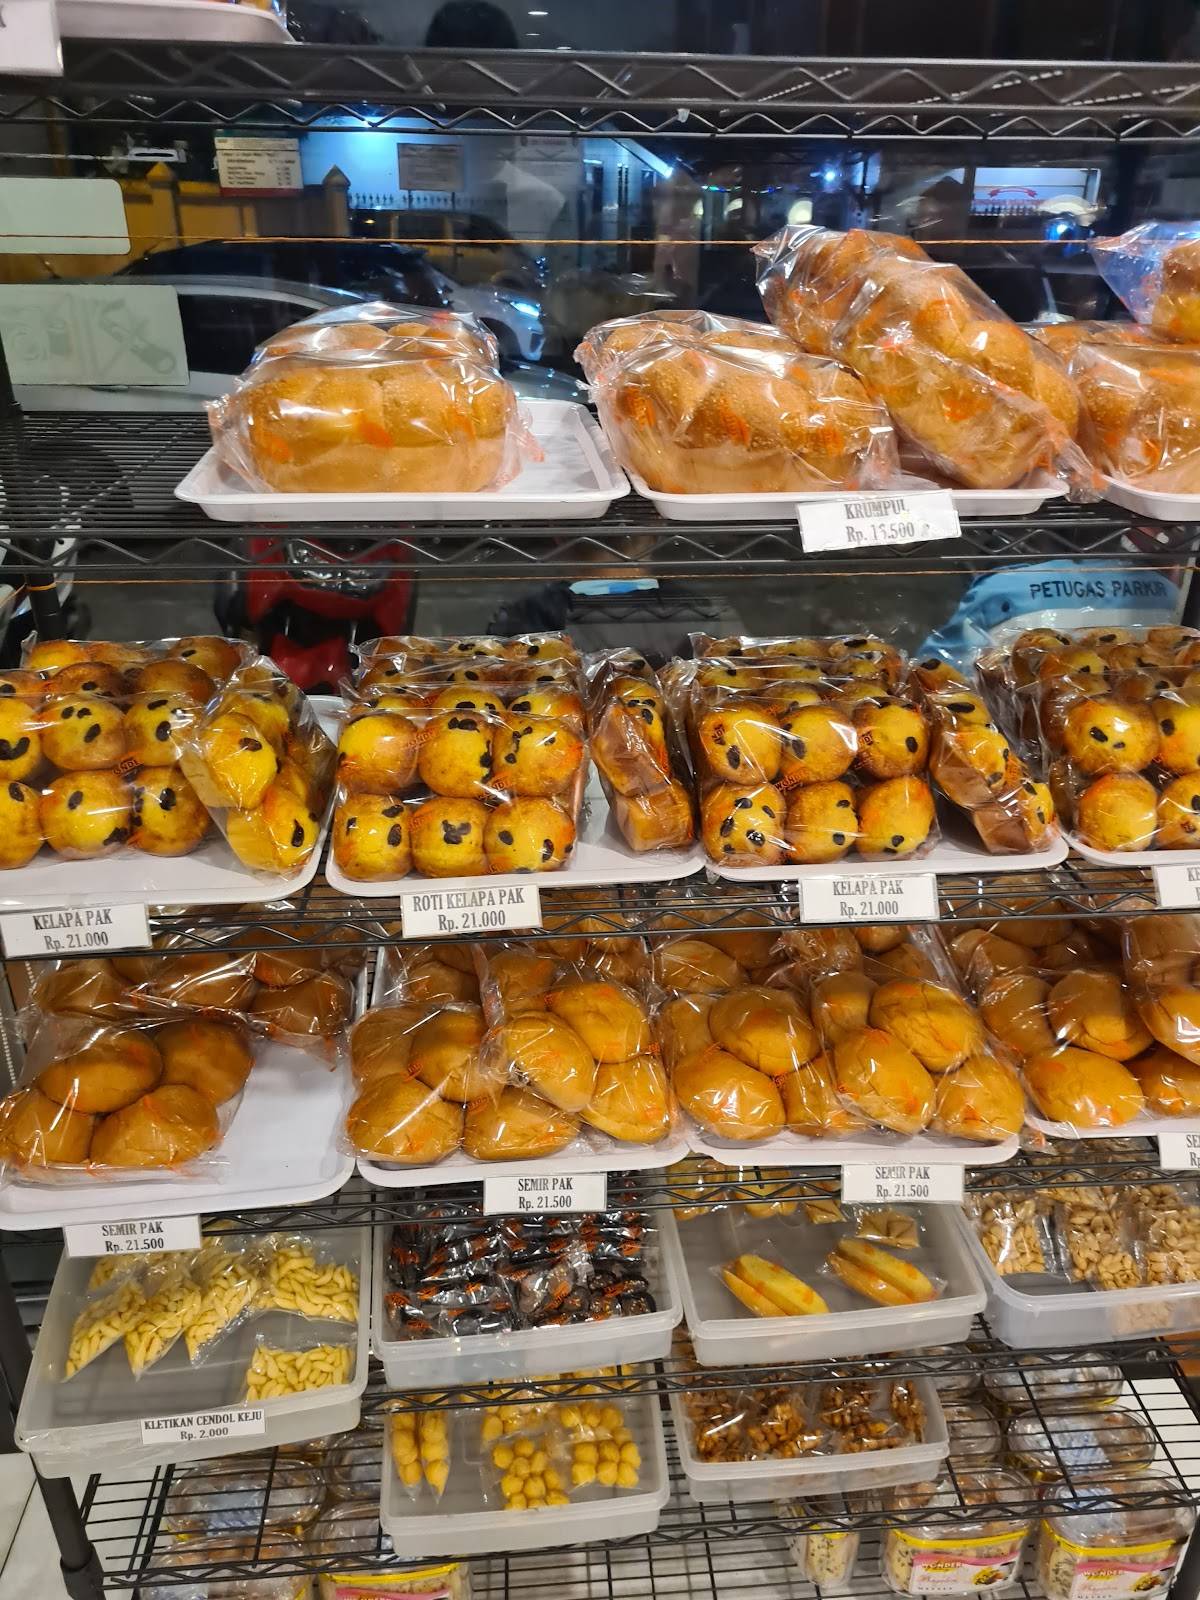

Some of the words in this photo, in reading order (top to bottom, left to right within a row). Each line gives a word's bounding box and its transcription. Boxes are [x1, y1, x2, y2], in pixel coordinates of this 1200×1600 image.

[845, 526, 868, 545] Rp.
[1029, 580, 1106, 600] PETUGAS
[832, 880, 878, 896] KELAPA
[880, 880, 904, 895] PAK
[413, 894, 443, 912] ROTI
[446, 890, 496, 909] KELAPA
[499, 887, 524, 905] PAK
[840, 901, 858, 918] Rp.
[860, 900, 899, 915] 21.000
[32, 910, 83, 930] KELAPA
[85, 908, 113, 926] PAK
[438, 914, 459, 932] Rp.
[461, 910, 506, 929] 21.000
[44, 935, 65, 951] Rp.
[66, 931, 109, 949] 21.000
[875, 1166, 906, 1180] SEMIR
[908, 1166, 930, 1179] PAK
[518, 1178, 549, 1191] SEMIR
[552, 1177, 573, 1190] PAK
[876, 1184, 892, 1199] Rp.
[894, 1184, 929, 1197] 21.500
[518, 1196, 534, 1211] Rp.
[537, 1195, 572, 1209] 21.500
[102, 1223, 137, 1236] SEMIR
[140, 1221, 164, 1234] PAK
[105, 1240, 123, 1253] Rp.
[126, 1237, 164, 1251] 21.500
[144, 1416, 193, 1430] KLETIKAN
[196, 1413, 235, 1426] CENDOL
[238, 1410, 262, 1422] KEJU
[180, 1431, 197, 1440] Rp.
[199, 1427, 229, 1438] 2.000
